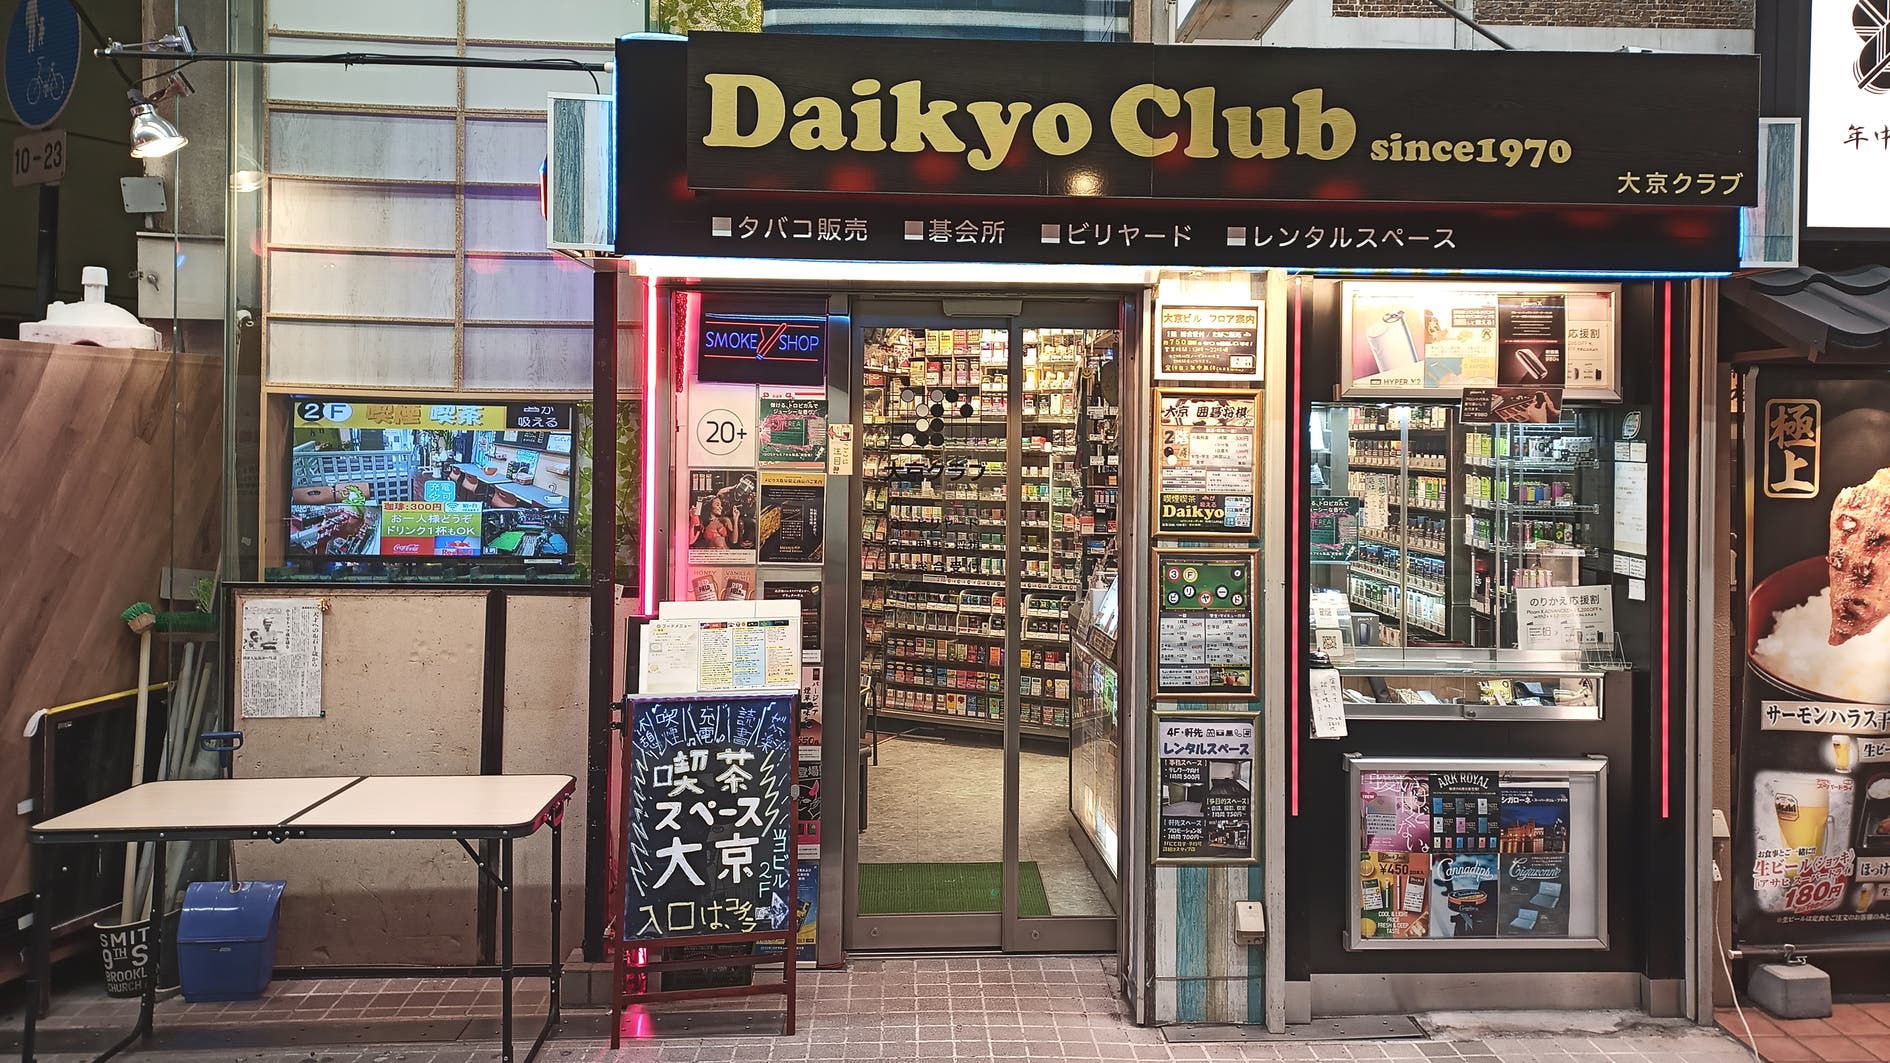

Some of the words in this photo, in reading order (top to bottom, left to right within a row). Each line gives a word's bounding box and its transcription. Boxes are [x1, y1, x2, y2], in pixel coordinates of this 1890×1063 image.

[703, 74, 1092, 171] Daikyo
[1110, 83, 1357, 160] Club
[1370, 131, 1571, 168] since1970
[15, 140, 62, 175] 10-23
[1617, 171, 1743, 194] 大京クラブ
[738, 216, 868, 243] タバコ販売
[928, 218, 1004, 244] 碁会所
[1067, 223, 1192, 247] ビリヤード
[1253, 225, 1457, 249] レンタルスペース
[1163, 313, 1202, 323] 大京ビル
[1209, 313, 1255, 324] フロア案内
[705, 331, 758, 350] SMOKE
[778, 334, 820, 351] SHOP
[1568, 328, 1601, 339] 応援割
[430, 405, 485, 425] 喫茶
[518, 417, 558, 427] 吸える
[1165, 406, 1189, 417] 大京
[1196, 406, 1248, 418] 囲碁将棋
[705, 420, 747, 443] 20+
[1769, 404, 1815, 493] 極上
[391, 514, 473, 524] お一人様どうぞ
[1163, 505, 1225, 520] Daikyo
[387, 526, 475, 535] ドリンク1杯もOK
[655, 708, 685, 746] 喫煙
[698, 705, 716, 744] 充電
[1166, 727, 1204, 738] 4F・軒先
[1163, 742, 1250, 756] レンタルスペース
[653, 748, 756, 797] 喫茶
[1437, 774, 1458, 788] ARK
[1459, 772, 1490, 789] ROYAL
[655, 797, 763, 830] スペース
[652, 832, 760, 889] 大京
[772, 828, 790, 889] 当ビル
[1379, 863, 1409, 875] ¥450
[1437, 858, 1494, 882] Cannadips
[758, 861, 772, 898] 2F
[1785, 882, 1843, 909] 180円
[108, 980, 142, 993] CHURCH
